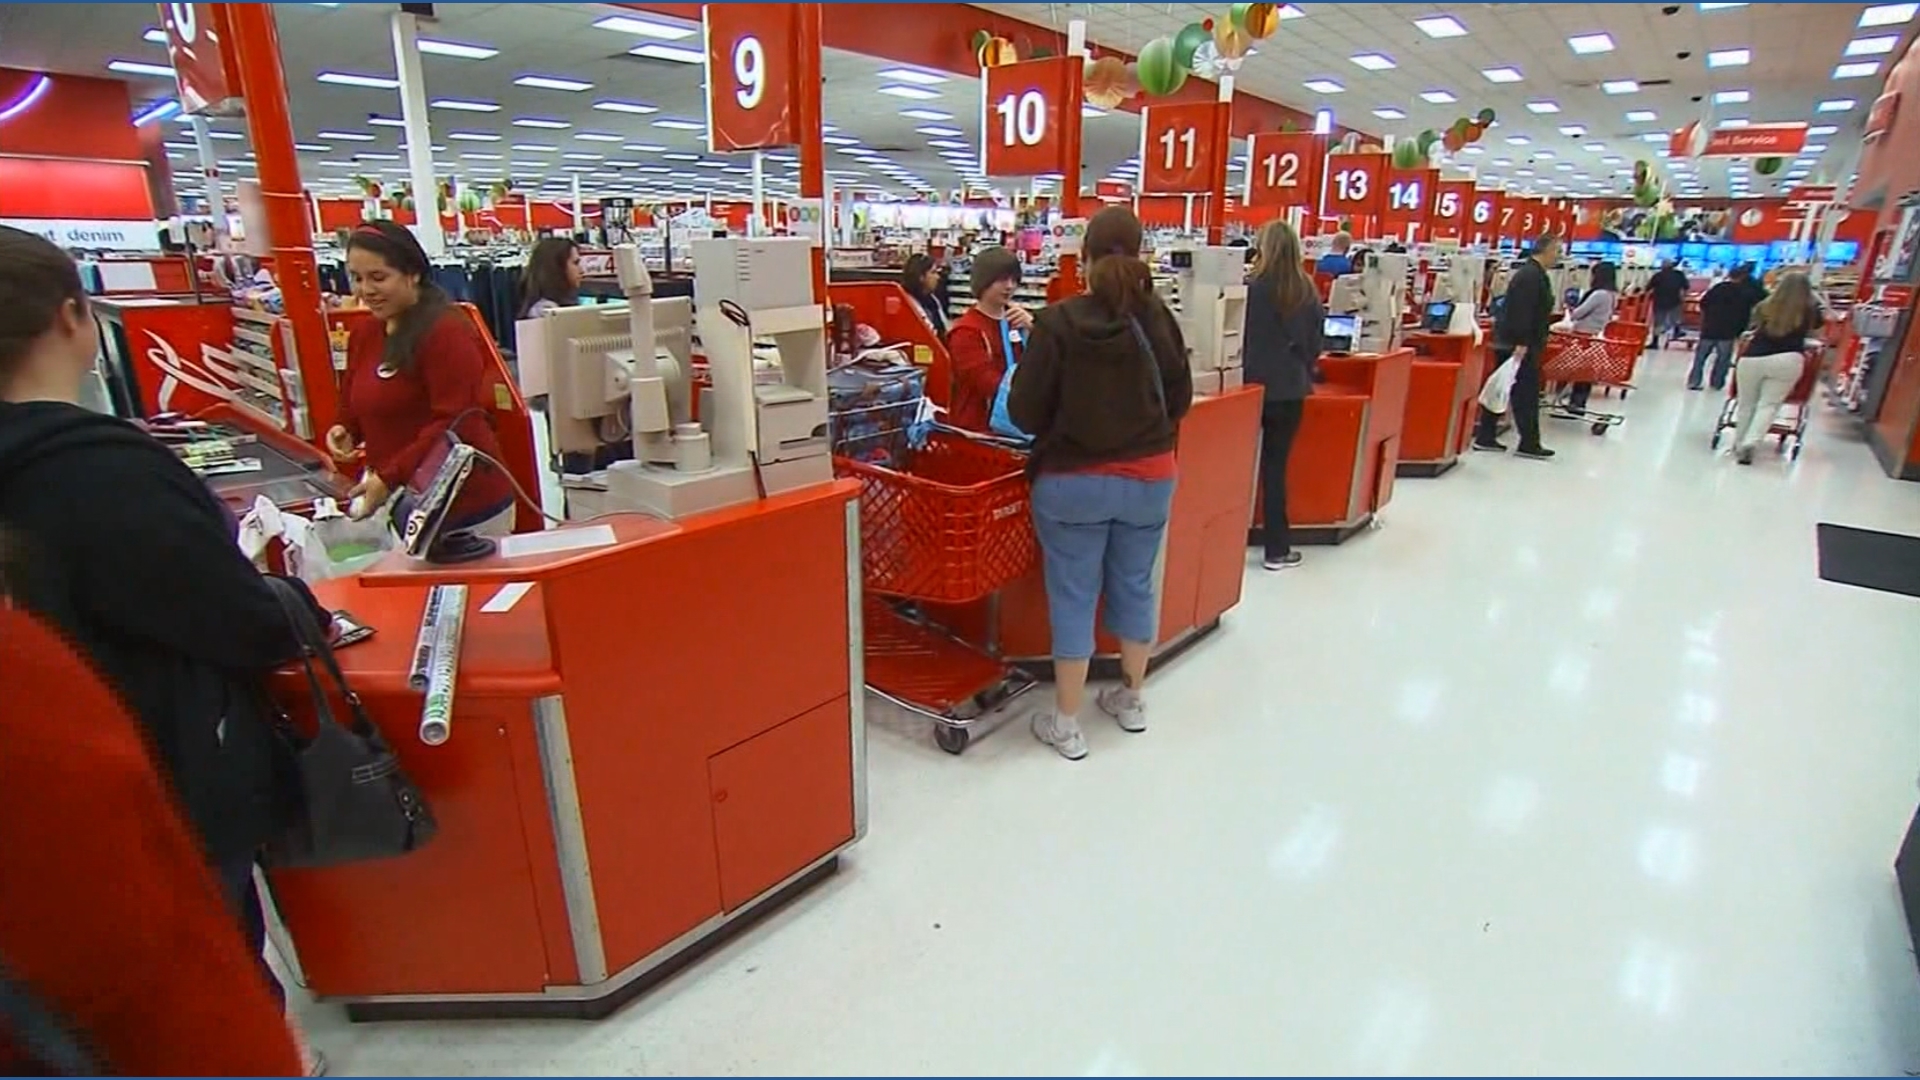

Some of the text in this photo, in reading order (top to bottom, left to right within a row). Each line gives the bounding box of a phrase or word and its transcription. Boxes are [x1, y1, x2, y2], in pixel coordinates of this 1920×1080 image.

[734, 36, 766, 110] 9
[996, 91, 1046, 147] 10
[1159, 127, 1196, 170] 11
[1261, 152, 1300, 188] 12
[1334, 169, 1368, 201] 13
[1389, 182, 1420, 210] 14
[1473, 200, 1490, 223] 6
[1501, 207, 1514, 226] 7
[67, 228, 126, 243] denim
